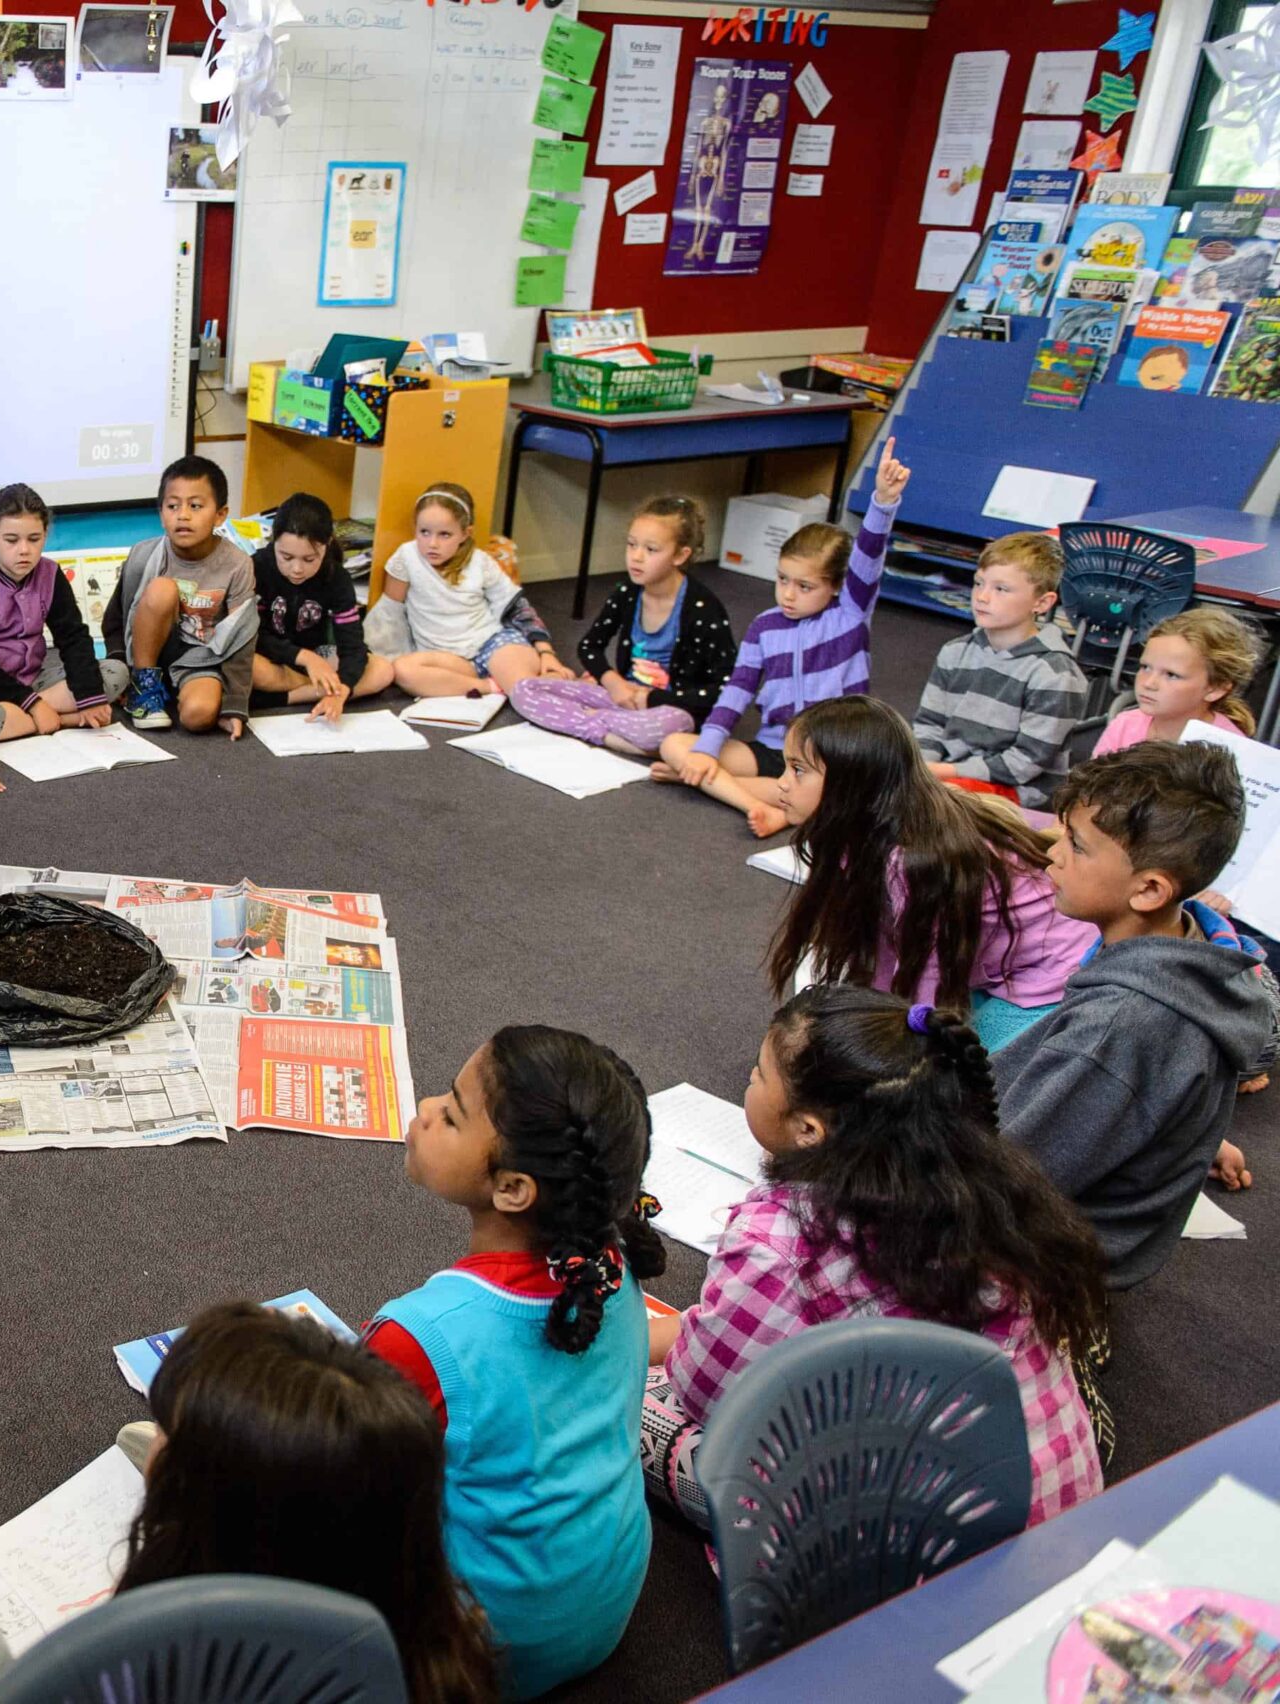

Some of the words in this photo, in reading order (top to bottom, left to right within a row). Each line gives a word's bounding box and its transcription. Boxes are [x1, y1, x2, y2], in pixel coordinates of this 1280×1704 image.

[701, 8, 830, 48] WRITING
[630, 42, 642, 51] Key
[644, 42, 662, 51] Bone
[632, 58, 655, 67] Words
[700, 65, 730, 79] Know
[732, 66, 757, 80] Your
[758, 68, 787, 81] Bones
[1008, 223, 1035, 233] BLUE
[293, 1063, 307, 1081] SLE
[141, 1125, 221, 1140] Entertainment
